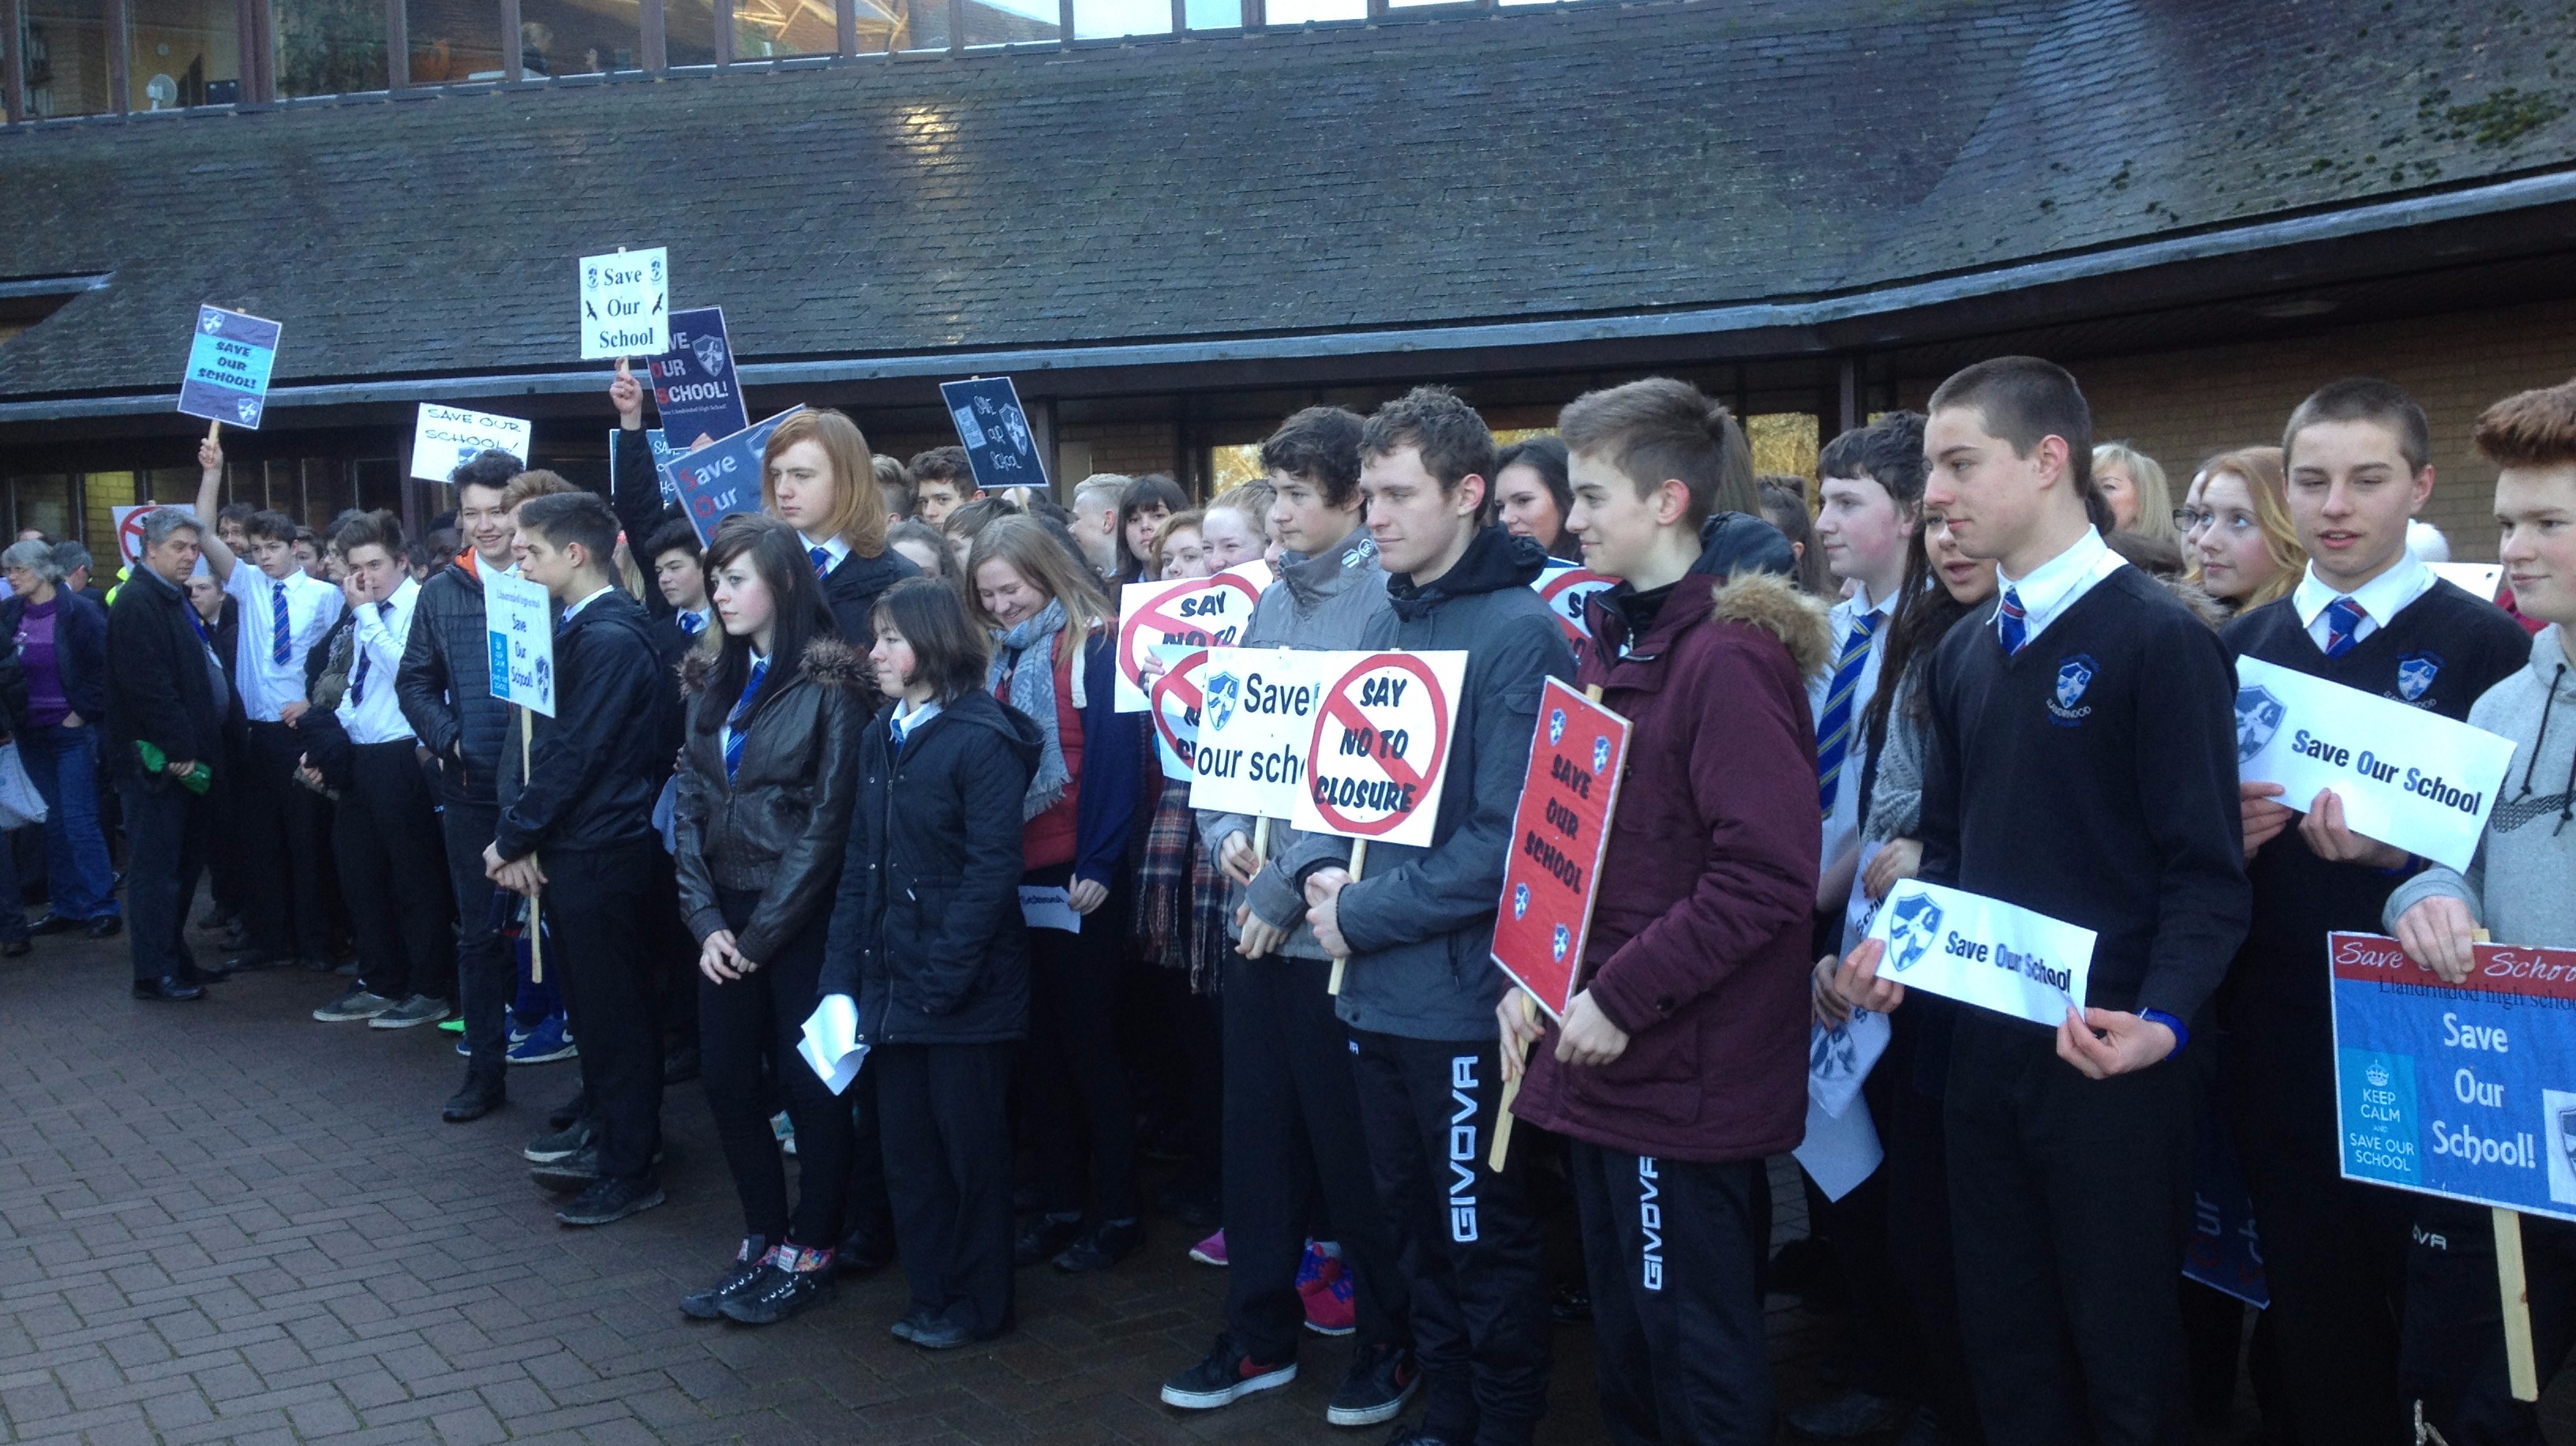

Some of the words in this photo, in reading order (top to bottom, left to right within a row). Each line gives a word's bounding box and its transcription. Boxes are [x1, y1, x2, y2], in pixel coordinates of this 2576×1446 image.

[604, 268, 642, 286] Save
[608, 298, 641, 317] Our
[215, 341, 251, 357] SAVE
[599, 328, 653, 348] School
[198, 367, 256, 388] SCHOOL!
[217, 357, 247, 371] OUR
[650, 359, 686, 379] OUR
[656, 380, 729, 405] SCHOOL!
[428, 409, 472, 424] SAVE
[479, 417, 521, 432] OUR
[425, 429, 519, 452] SCHOOL!
[680, 455, 738, 491] Save
[694, 487, 738, 518] Our
[1180, 590, 1226, 617] SAY
[1244, 672, 1309, 716] Save
[1360, 677, 1407, 708] SAY
[1339, 727, 1373, 757] NO
[1379, 729, 1409, 759] TO
[1197, 747, 1243, 778] our
[1249, 744, 1305, 785] sch
[1551, 754, 1592, 800] SAVE
[2292, 729, 2349, 767] Save
[2356, 750, 2400, 784] Our
[2403, 767, 2482, 816] School
[1312, 775, 1417, 813] CLOSURE
[1546, 797, 1579, 841] OUR
[1524, 830, 1583, 895] SCHOOL
[1945, 931, 1988, 962] Save
[1994, 943, 2023, 972] Our
[2024, 953, 2072, 993] School
[2336, 942, 2404, 968] Save
[2379, 974, 2481, 1002] Llandrindod
[2485, 984, 2524, 1010] high
[2530, 989, 2576, 1011] scho
[2443, 1013, 2509, 1053] Save
[2362, 1088, 2396, 1105] KEEP
[2454, 1068, 2505, 1107] Our
[2361, 1105, 2400, 1122] CALM
[1449, 1055, 1479, 1242] GIVOVA
[2349, 1133, 2381, 1151] SAVE
[2386, 1139, 2415, 1156] OUR
[2432, 1120, 2537, 1169] School!
[2356, 1152, 2411, 1172] SCHOOL
[1638, 1156, 1663, 1291] GIVOVA
